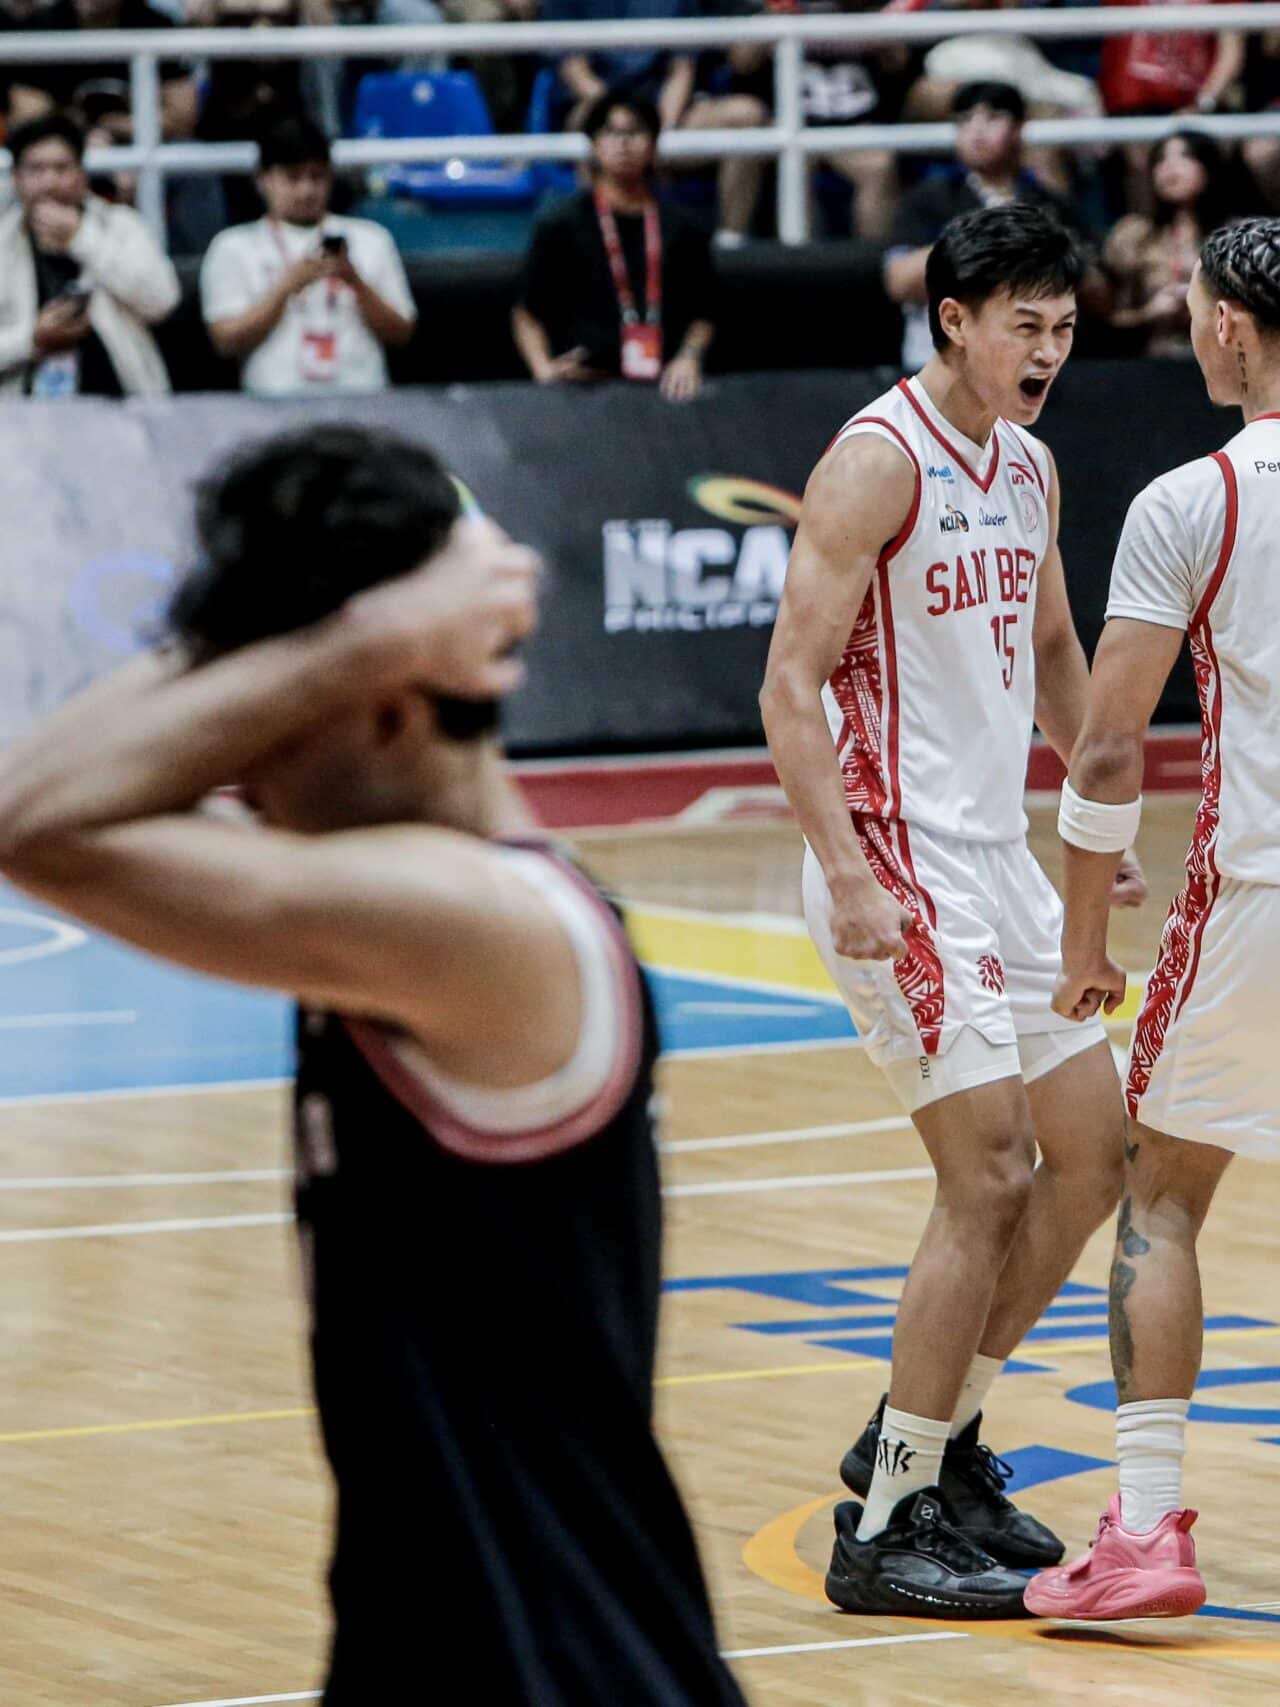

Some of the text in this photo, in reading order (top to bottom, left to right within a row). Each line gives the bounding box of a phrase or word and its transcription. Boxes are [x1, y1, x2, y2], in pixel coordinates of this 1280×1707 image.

[602, 520, 791, 604] NCA
[925, 547, 1037, 616] SAN BE
[990, 614, 1018, 690] 15
